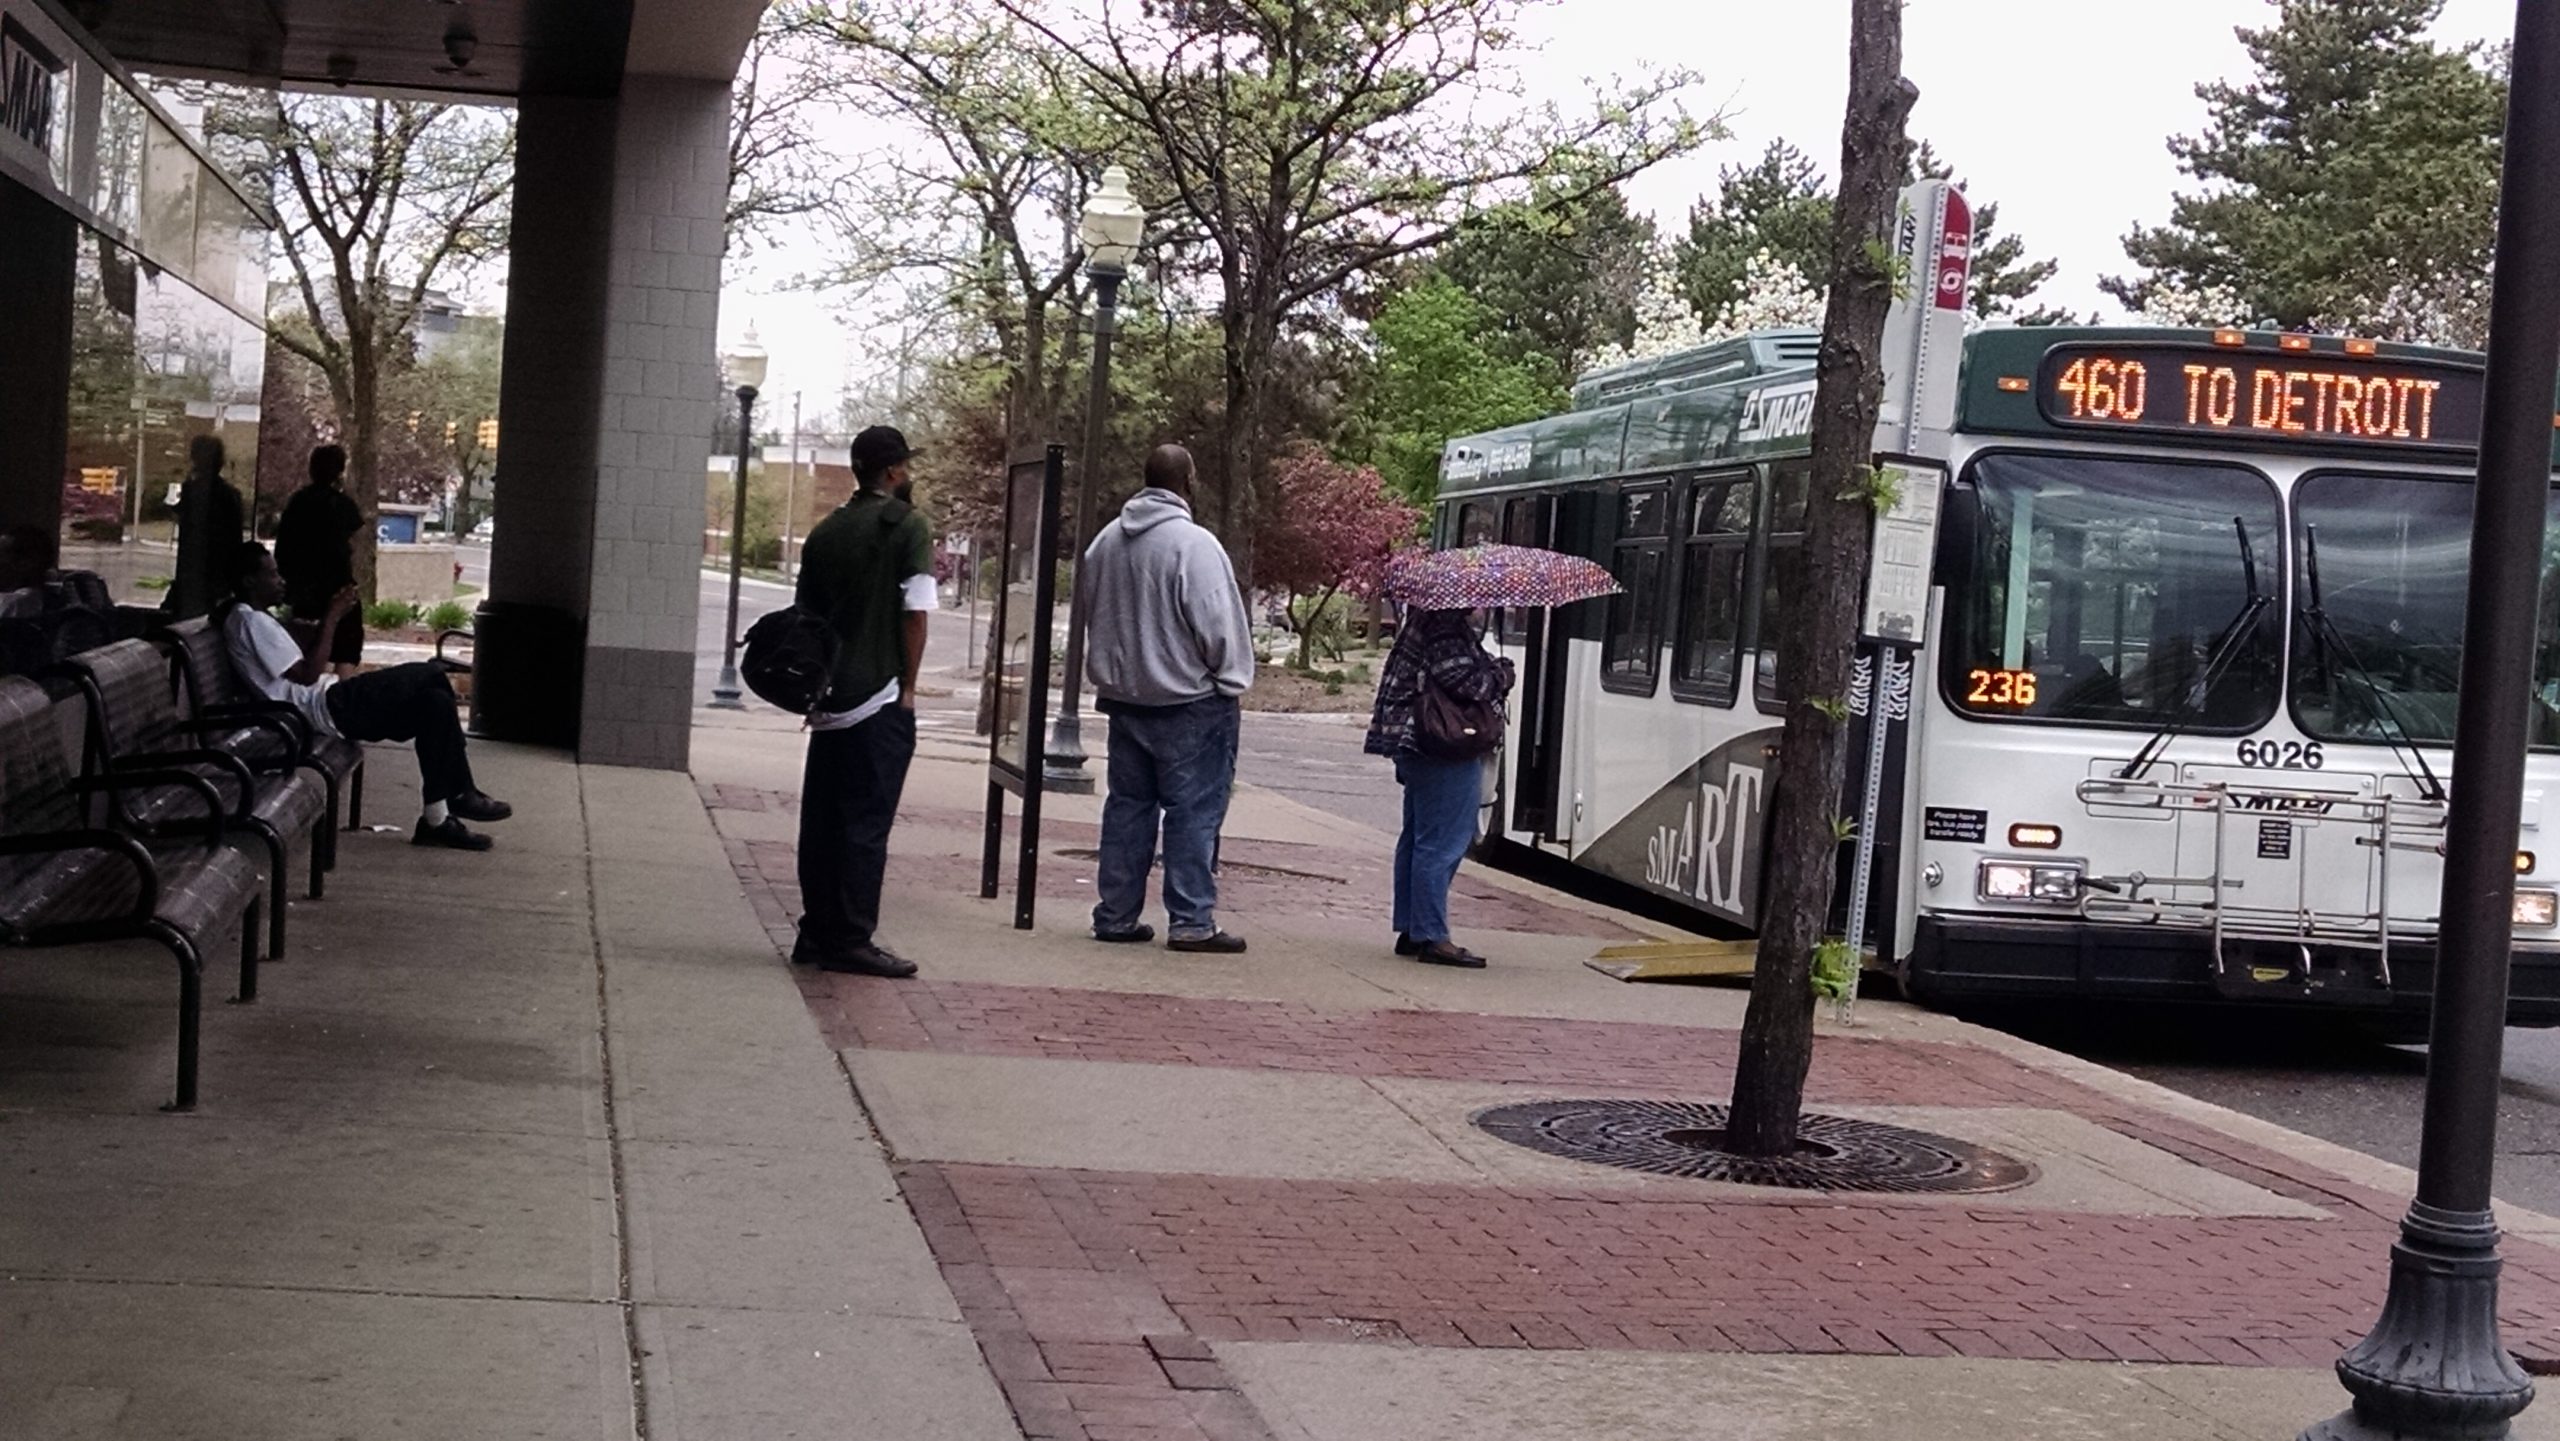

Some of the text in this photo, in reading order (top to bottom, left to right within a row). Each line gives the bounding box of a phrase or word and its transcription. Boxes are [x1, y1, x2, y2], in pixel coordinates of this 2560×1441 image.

[2058, 358, 2440, 440] 460 TO DETROIT
[1968, 669, 2037, 705] 236
[2236, 738, 2324, 770] 6026
[1646, 761, 1764, 915] SMART
